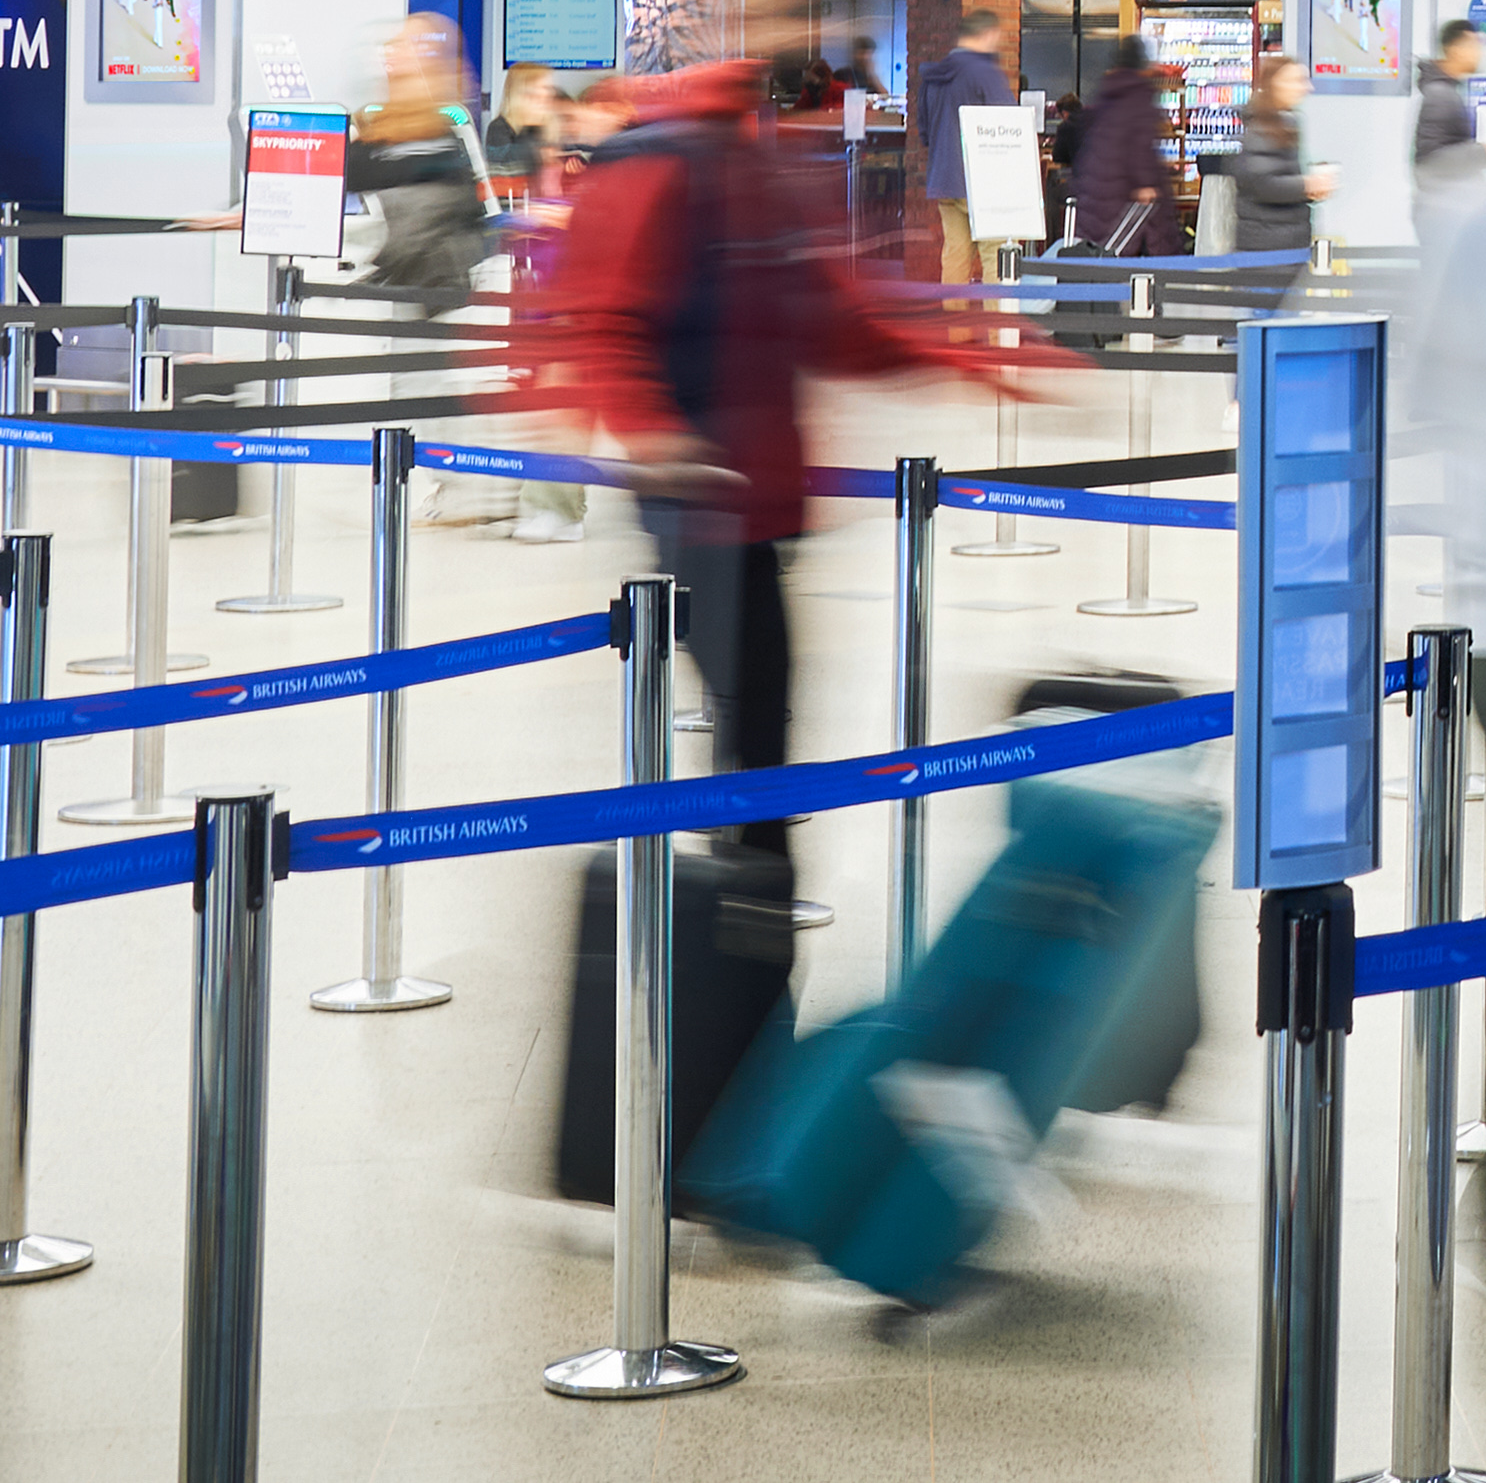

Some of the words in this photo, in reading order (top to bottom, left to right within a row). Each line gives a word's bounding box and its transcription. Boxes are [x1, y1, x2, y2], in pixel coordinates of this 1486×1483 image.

[107, 64, 134, 76] NETFLIX
[977, 125, 996, 138] Bag
[998, 125, 1022, 137] Drop
[252, 136, 323, 152] SKYPRIORITY
[245, 443, 276, 457] BRITISH
[276, 445, 310, 457] AIRWAYS
[456, 452, 488, 467] BRITISH
[489, 457, 524, 471] AIRWAYS
[988, 492, 1025, 507] BRITISH
[1026, 495, 1066, 510] AIRWAYS
[253, 677, 308, 700] BRITISH
[310, 667, 367, 690] AIRWAYS
[923, 755, 977, 779] BRITISH
[979, 744, 1036, 768] AIRWAYS
[389, 822, 456, 848] BRITISH
[458, 815, 529, 839] AIRWAYS
